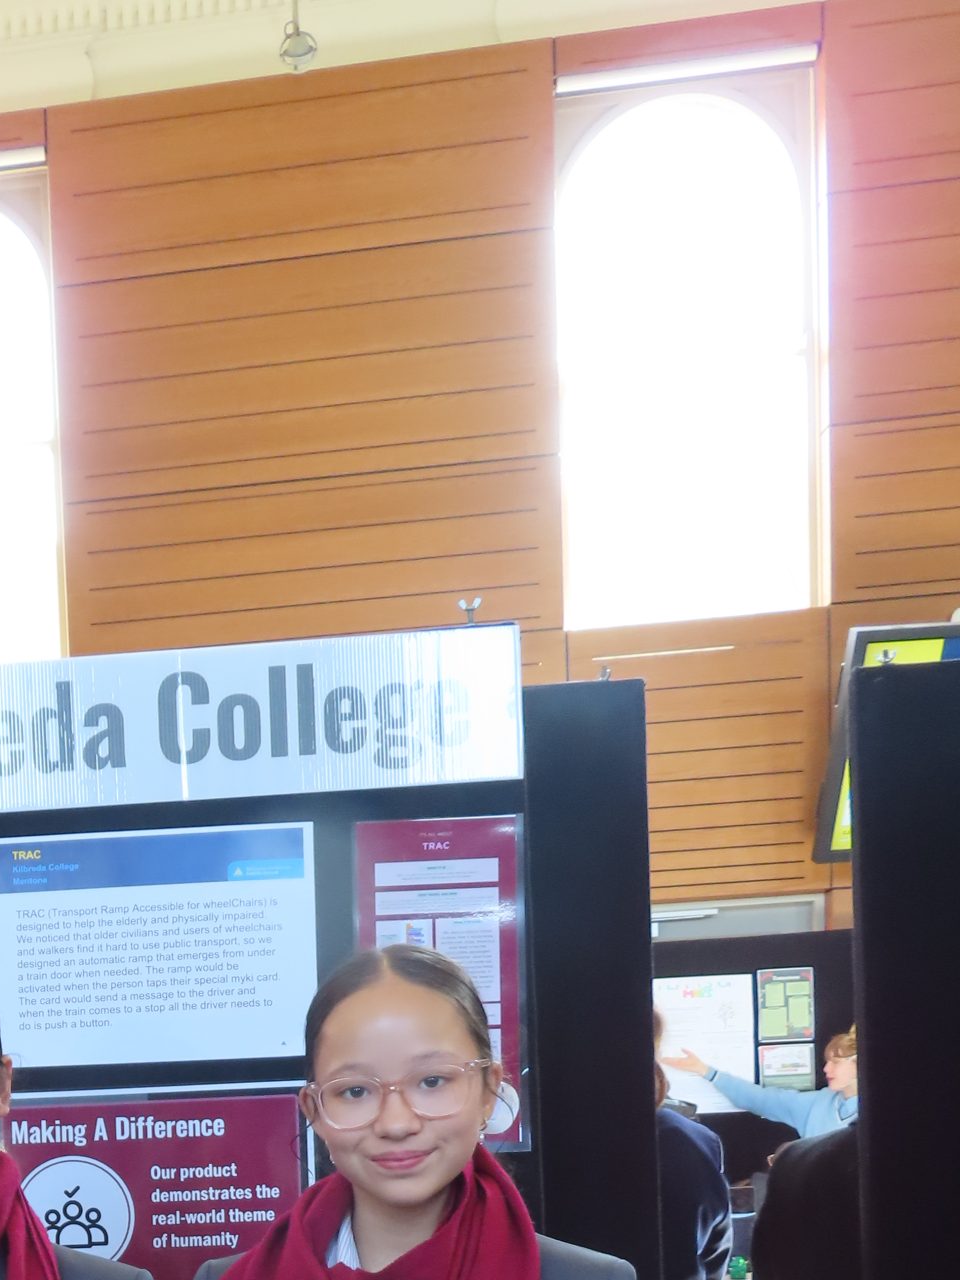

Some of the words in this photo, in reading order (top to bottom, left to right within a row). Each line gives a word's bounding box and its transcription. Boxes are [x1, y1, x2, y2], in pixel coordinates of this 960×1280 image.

[157, 663, 471, 770] College
[12, 850, 41, 860] TRAC
[422, 841, 450, 850] TRAC
[13, 864, 46, 873] Kilbreda
[48, 863, 79, 873] College
[13, 877, 47, 885] Mentone
[16, 909, 45, 919] TRAC
[48, 906, 98, 919] (Transport
[101, 905, 129, 914] Ramp
[132, 902, 184, 912] Accessible
[187, 901, 200, 910] for
[203, 898, 267, 909] wheelChairs)
[270, 897, 278, 906] is
[16, 922, 60, 932] designed
[62, 921, 72, 930] to
[74, 919, 95, 929] help
[98, 918, 113, 927] the
[116, 916, 148, 927] elderly
[151, 915, 169, 924] and
[172, 913, 219, 924] physically
[17, 935, 33, 944] We
[35, 933, 70, 943] noticed
[73, 931, 91, 941] that
[94, 930, 118, 940] older
[121, 928, 159, 938] civilians
[162, 927, 180, 936] and
[183, 926, 209, 935] users
[212, 924, 222, 934] of
[225, 922, 282, 933] wheelchairs
[17, 947, 34, 957] and
[38, 945, 74, 955] walkers
[77, 944, 94, 953] find
[97, 943, 103, 952] it
[106, 942, 127, 951] hard
[130, 942, 139, 951] to
[142, 942, 160, 950] use
[163, 939, 191, 950] public
[194, 937, 241, 948] transport,
[243, 937, 255, 945] so
[258, 936, 272, 944] we
[11, 1119, 87, 1147] Making
[94, 1117, 109, 1141] A
[115, 1114, 225, 1141] Difference
[150, 1165, 176, 1180] Our
[179, 1162, 237, 1182] product
[151, 1185, 252, 1203] demonstrates
[255, 1184, 280, 1199] the
[152, 1208, 225, 1226] real-world
[228, 1207, 275, 1223] theme
[153, 1233, 168, 1249] of
[171, 1230, 239, 1249] humanity
